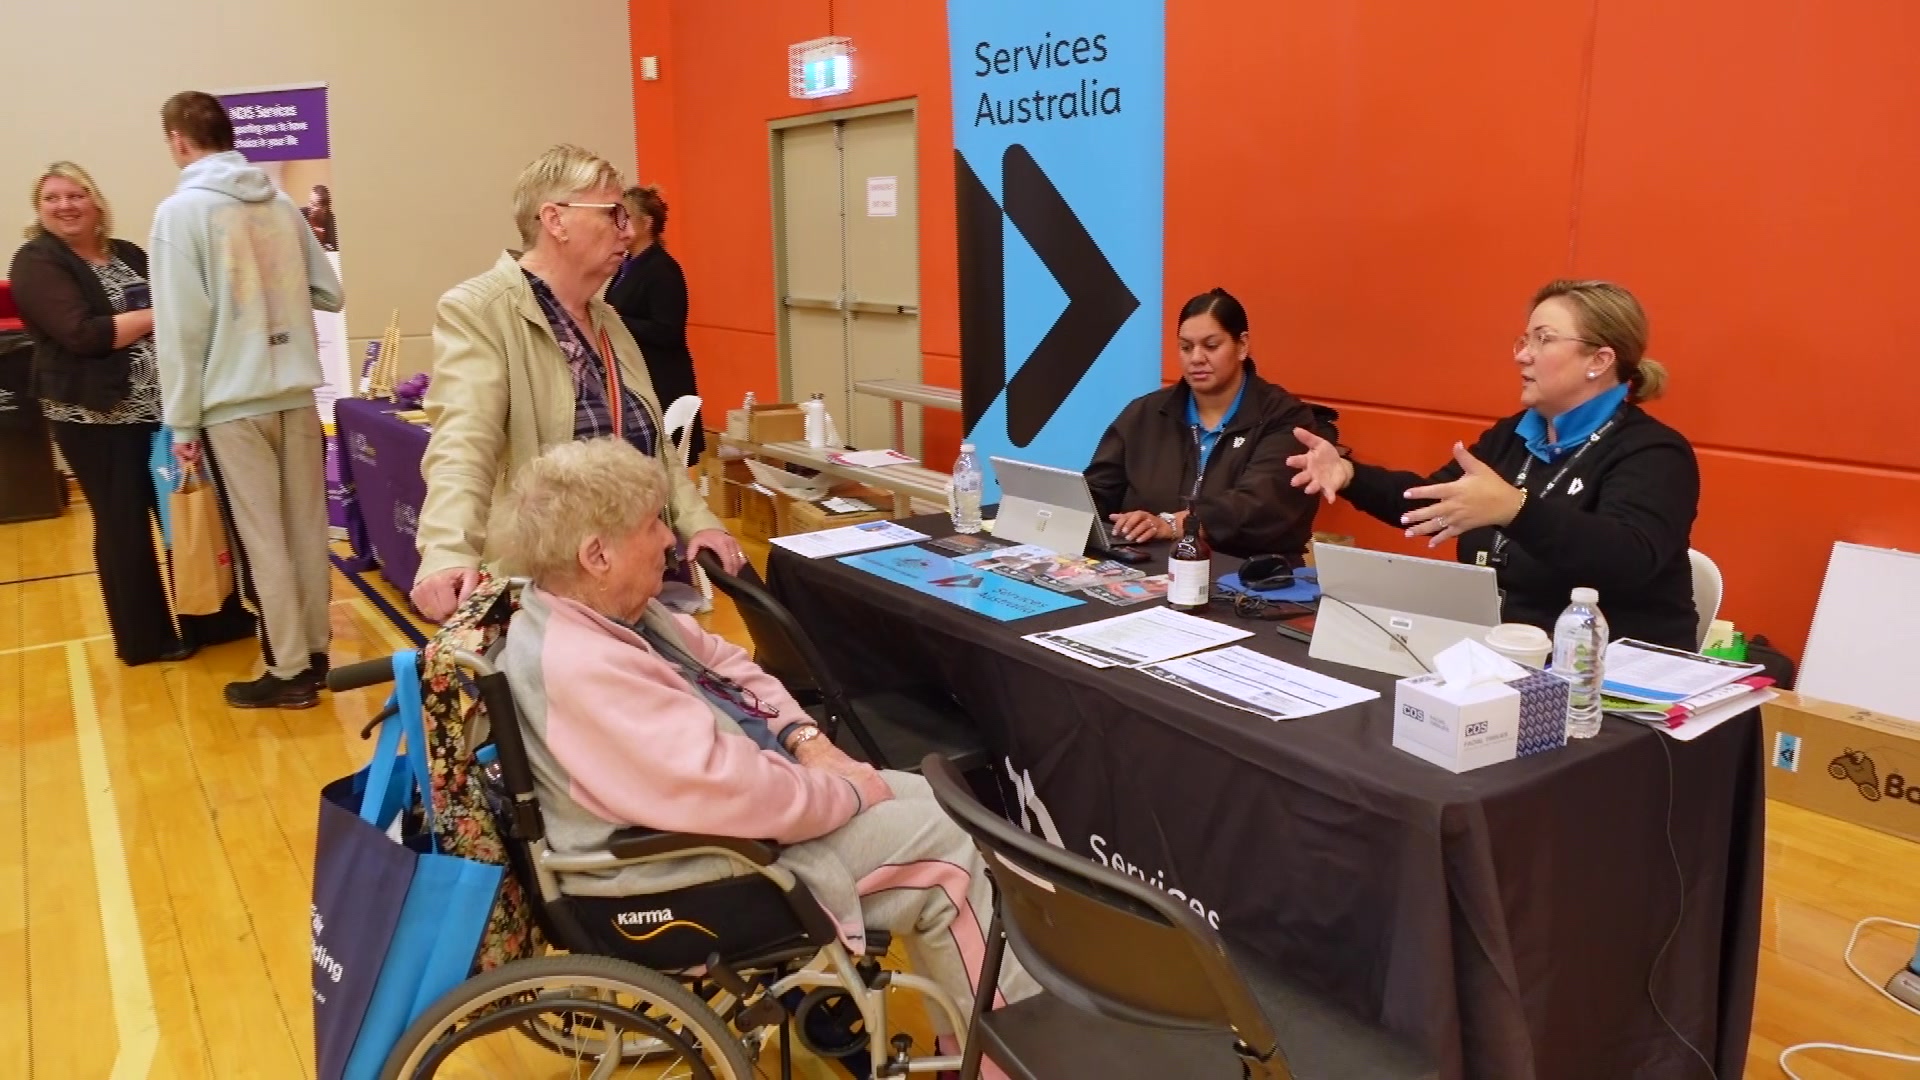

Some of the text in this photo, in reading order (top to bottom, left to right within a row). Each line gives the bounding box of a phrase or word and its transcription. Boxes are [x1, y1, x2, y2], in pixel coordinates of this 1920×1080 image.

[975, 31, 1108, 77] Services
[229, 103, 297, 120] NDIS Services
[974, 78, 1122, 128] Australia
[263, 124, 278, 135] you
[278, 121, 287, 132] to
[287, 120, 308, 131] have
[233, 138, 259, 149] choice
[267, 138, 285, 149] your
[285, 134, 298, 146] life
[1402, 704, 1424, 722] COS
[1464, 720, 1488, 737] COS
